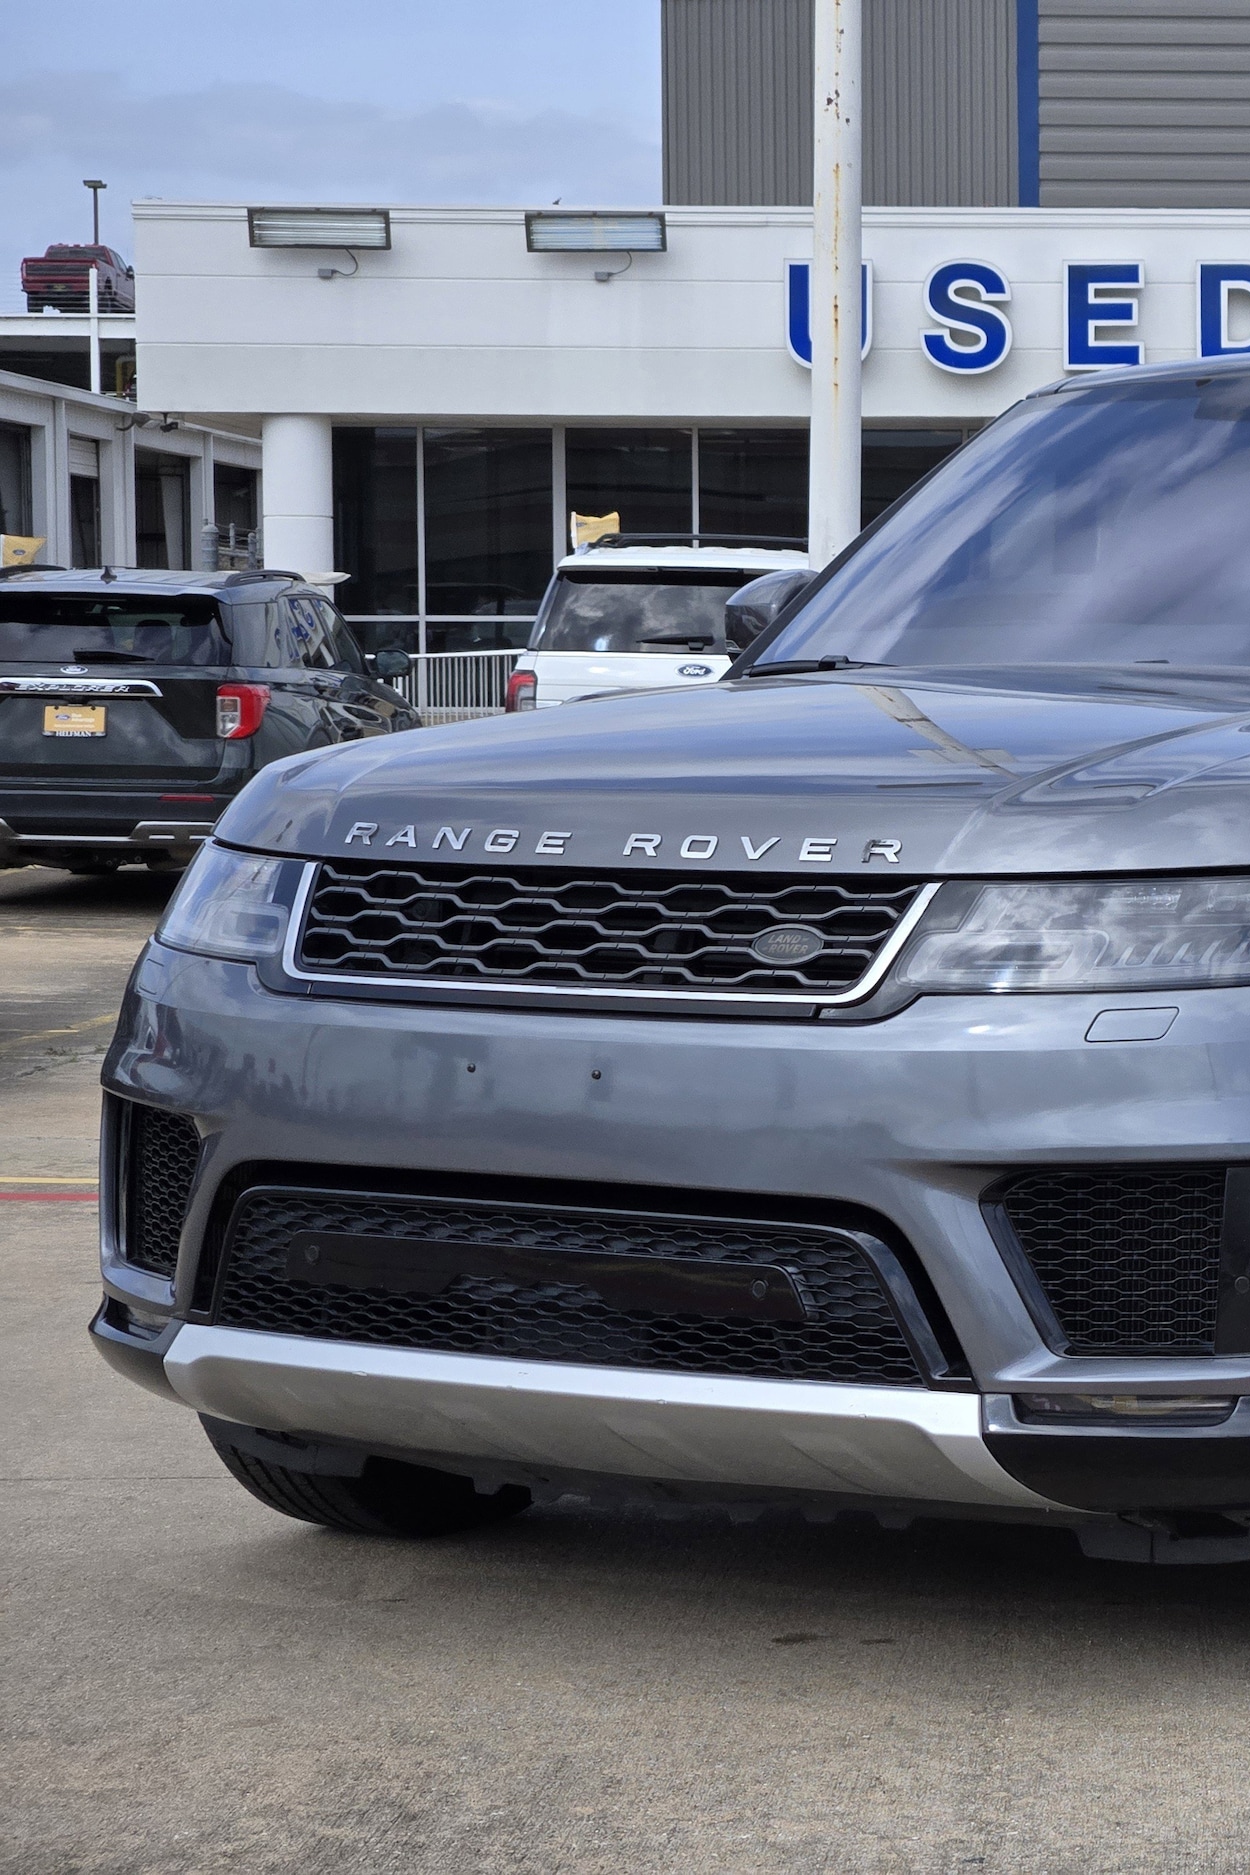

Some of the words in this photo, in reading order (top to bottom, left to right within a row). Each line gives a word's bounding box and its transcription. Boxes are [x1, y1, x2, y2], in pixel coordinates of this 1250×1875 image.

[15, 683, 130, 693] EXPLORER
[345, 821, 573, 855] RANGE
[622, 833, 903, 863] ROVER
